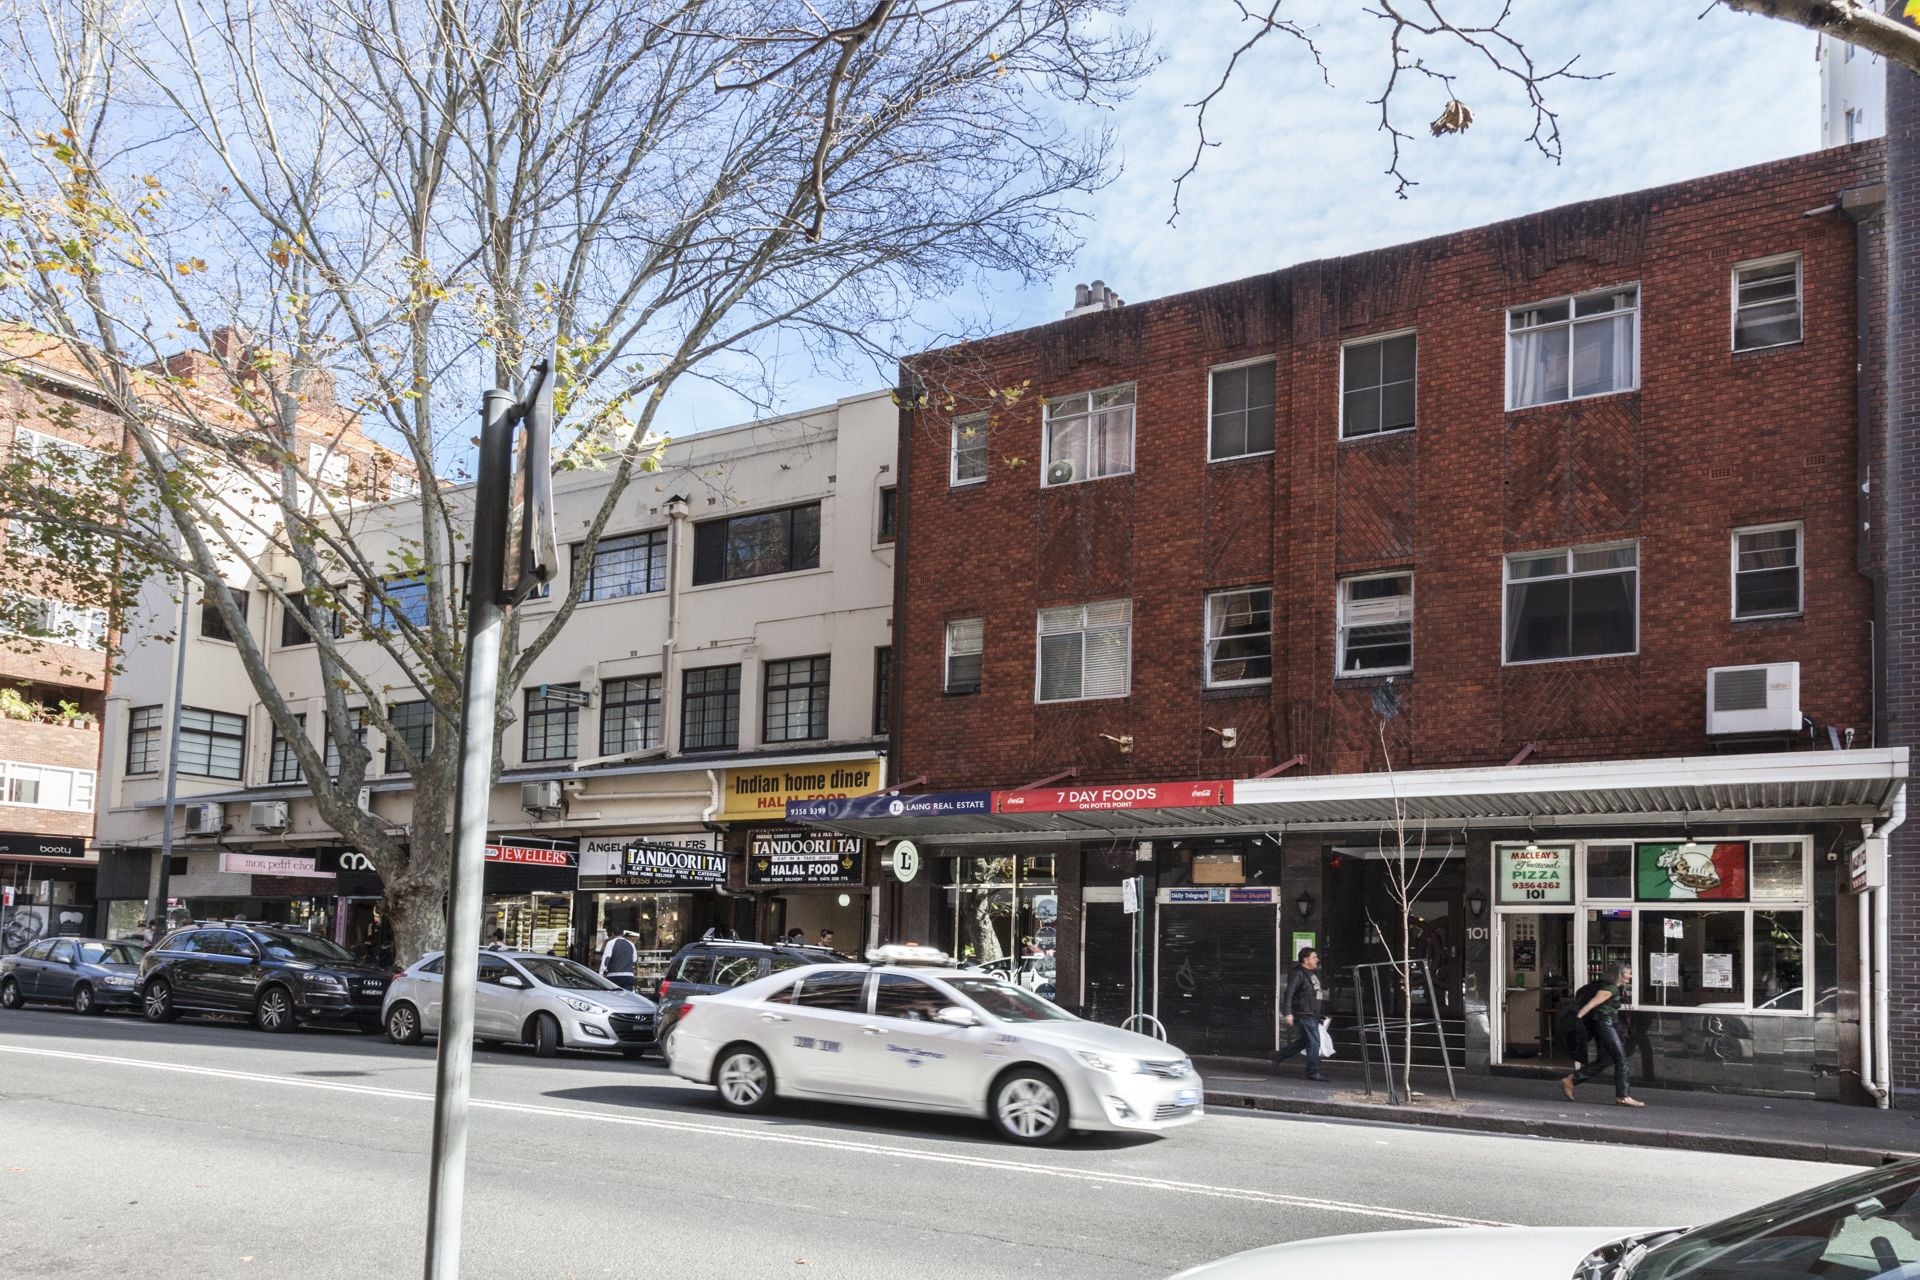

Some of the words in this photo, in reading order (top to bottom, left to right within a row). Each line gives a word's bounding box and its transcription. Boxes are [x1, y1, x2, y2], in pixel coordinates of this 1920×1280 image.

[735, 774, 779, 794] Indian
[785, 773, 826, 792] home
[830, 769, 870, 789] diner
[1057, 792, 1065, 803] 7
[1069, 790, 1099, 802] DAY
[1103, 788, 1157, 801] FOODS
[790, 808, 807, 816] 9358
[809, 807, 826, 815] 3399
[906, 803, 931, 811] LAING
[933, 802, 954, 810] REAL
[957, 801, 985, 809] ESTATE
[754, 840, 831, 854] TANDOORI
[837, 838, 861, 854] TAJ
[500, 847, 567, 864] JEWELLERS
[629, 849, 701, 870] TANDOORI
[706, 857, 727, 873] TAJ
[1510, 851, 1559, 860] MACLEAY'S
[245, 859, 265, 869] mon
[269, 860, 291, 872] petit
[771, 864, 805, 875] HALAL
[808, 863, 838, 875] FOOD
[1512, 870, 1560, 880] PIZZA
[1171, 892, 1184, 900] Daily
[1185, 891, 1209, 900] Telegraph
[1526, 889, 1545, 900] 101
[1466, 927, 1489, 940] 101
